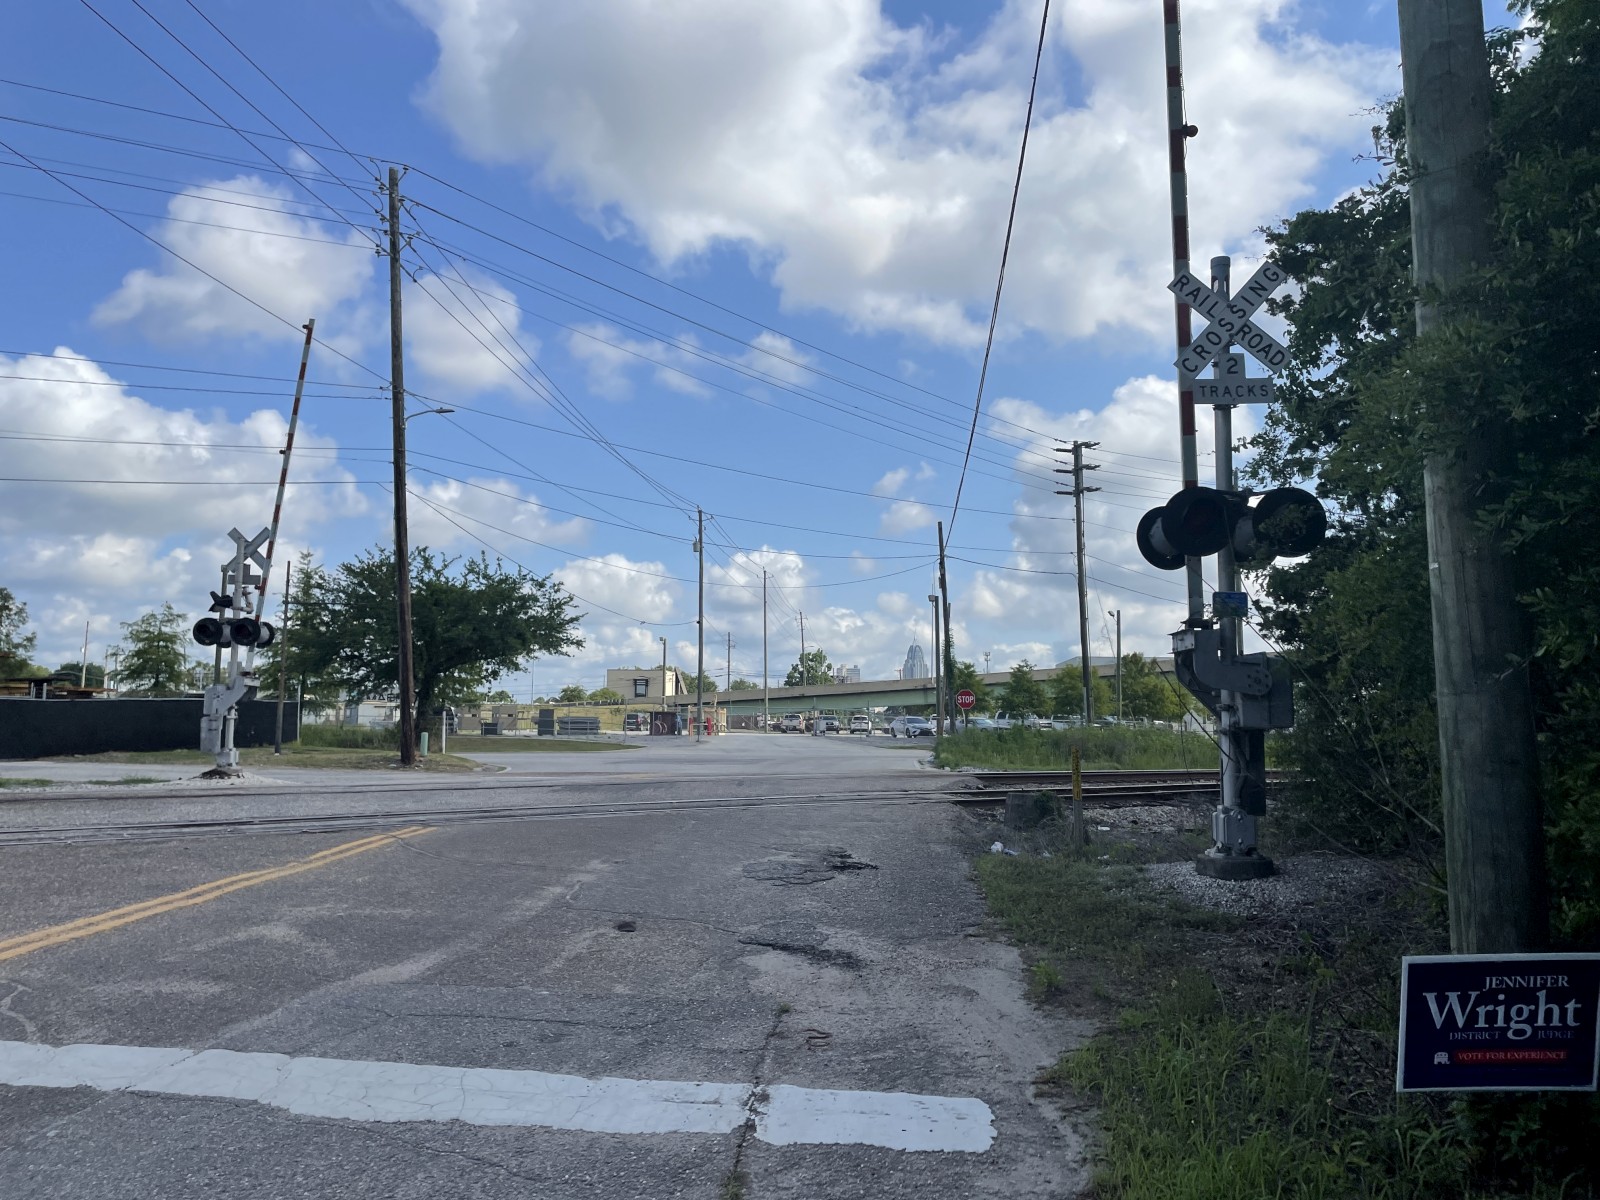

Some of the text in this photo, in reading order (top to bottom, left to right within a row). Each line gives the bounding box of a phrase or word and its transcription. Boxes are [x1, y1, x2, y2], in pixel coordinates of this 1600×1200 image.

[1173, 274, 1286, 366] RAILROAD
[1182, 267, 1280, 373] CROSSING
[1226, 357, 1239, 374] 2
[1199, 384, 1269, 398] TRACKS
[957, 695, 974, 703] STOP
[1483, 975, 1570, 991] JENNIFER
[1423, 989, 1582, 1040] Wright
[1449, 1030, 1574, 1041] DISTRICT JUDGE
[1458, 1051, 1568, 1060] VOTE FOR EXPERIENCE
